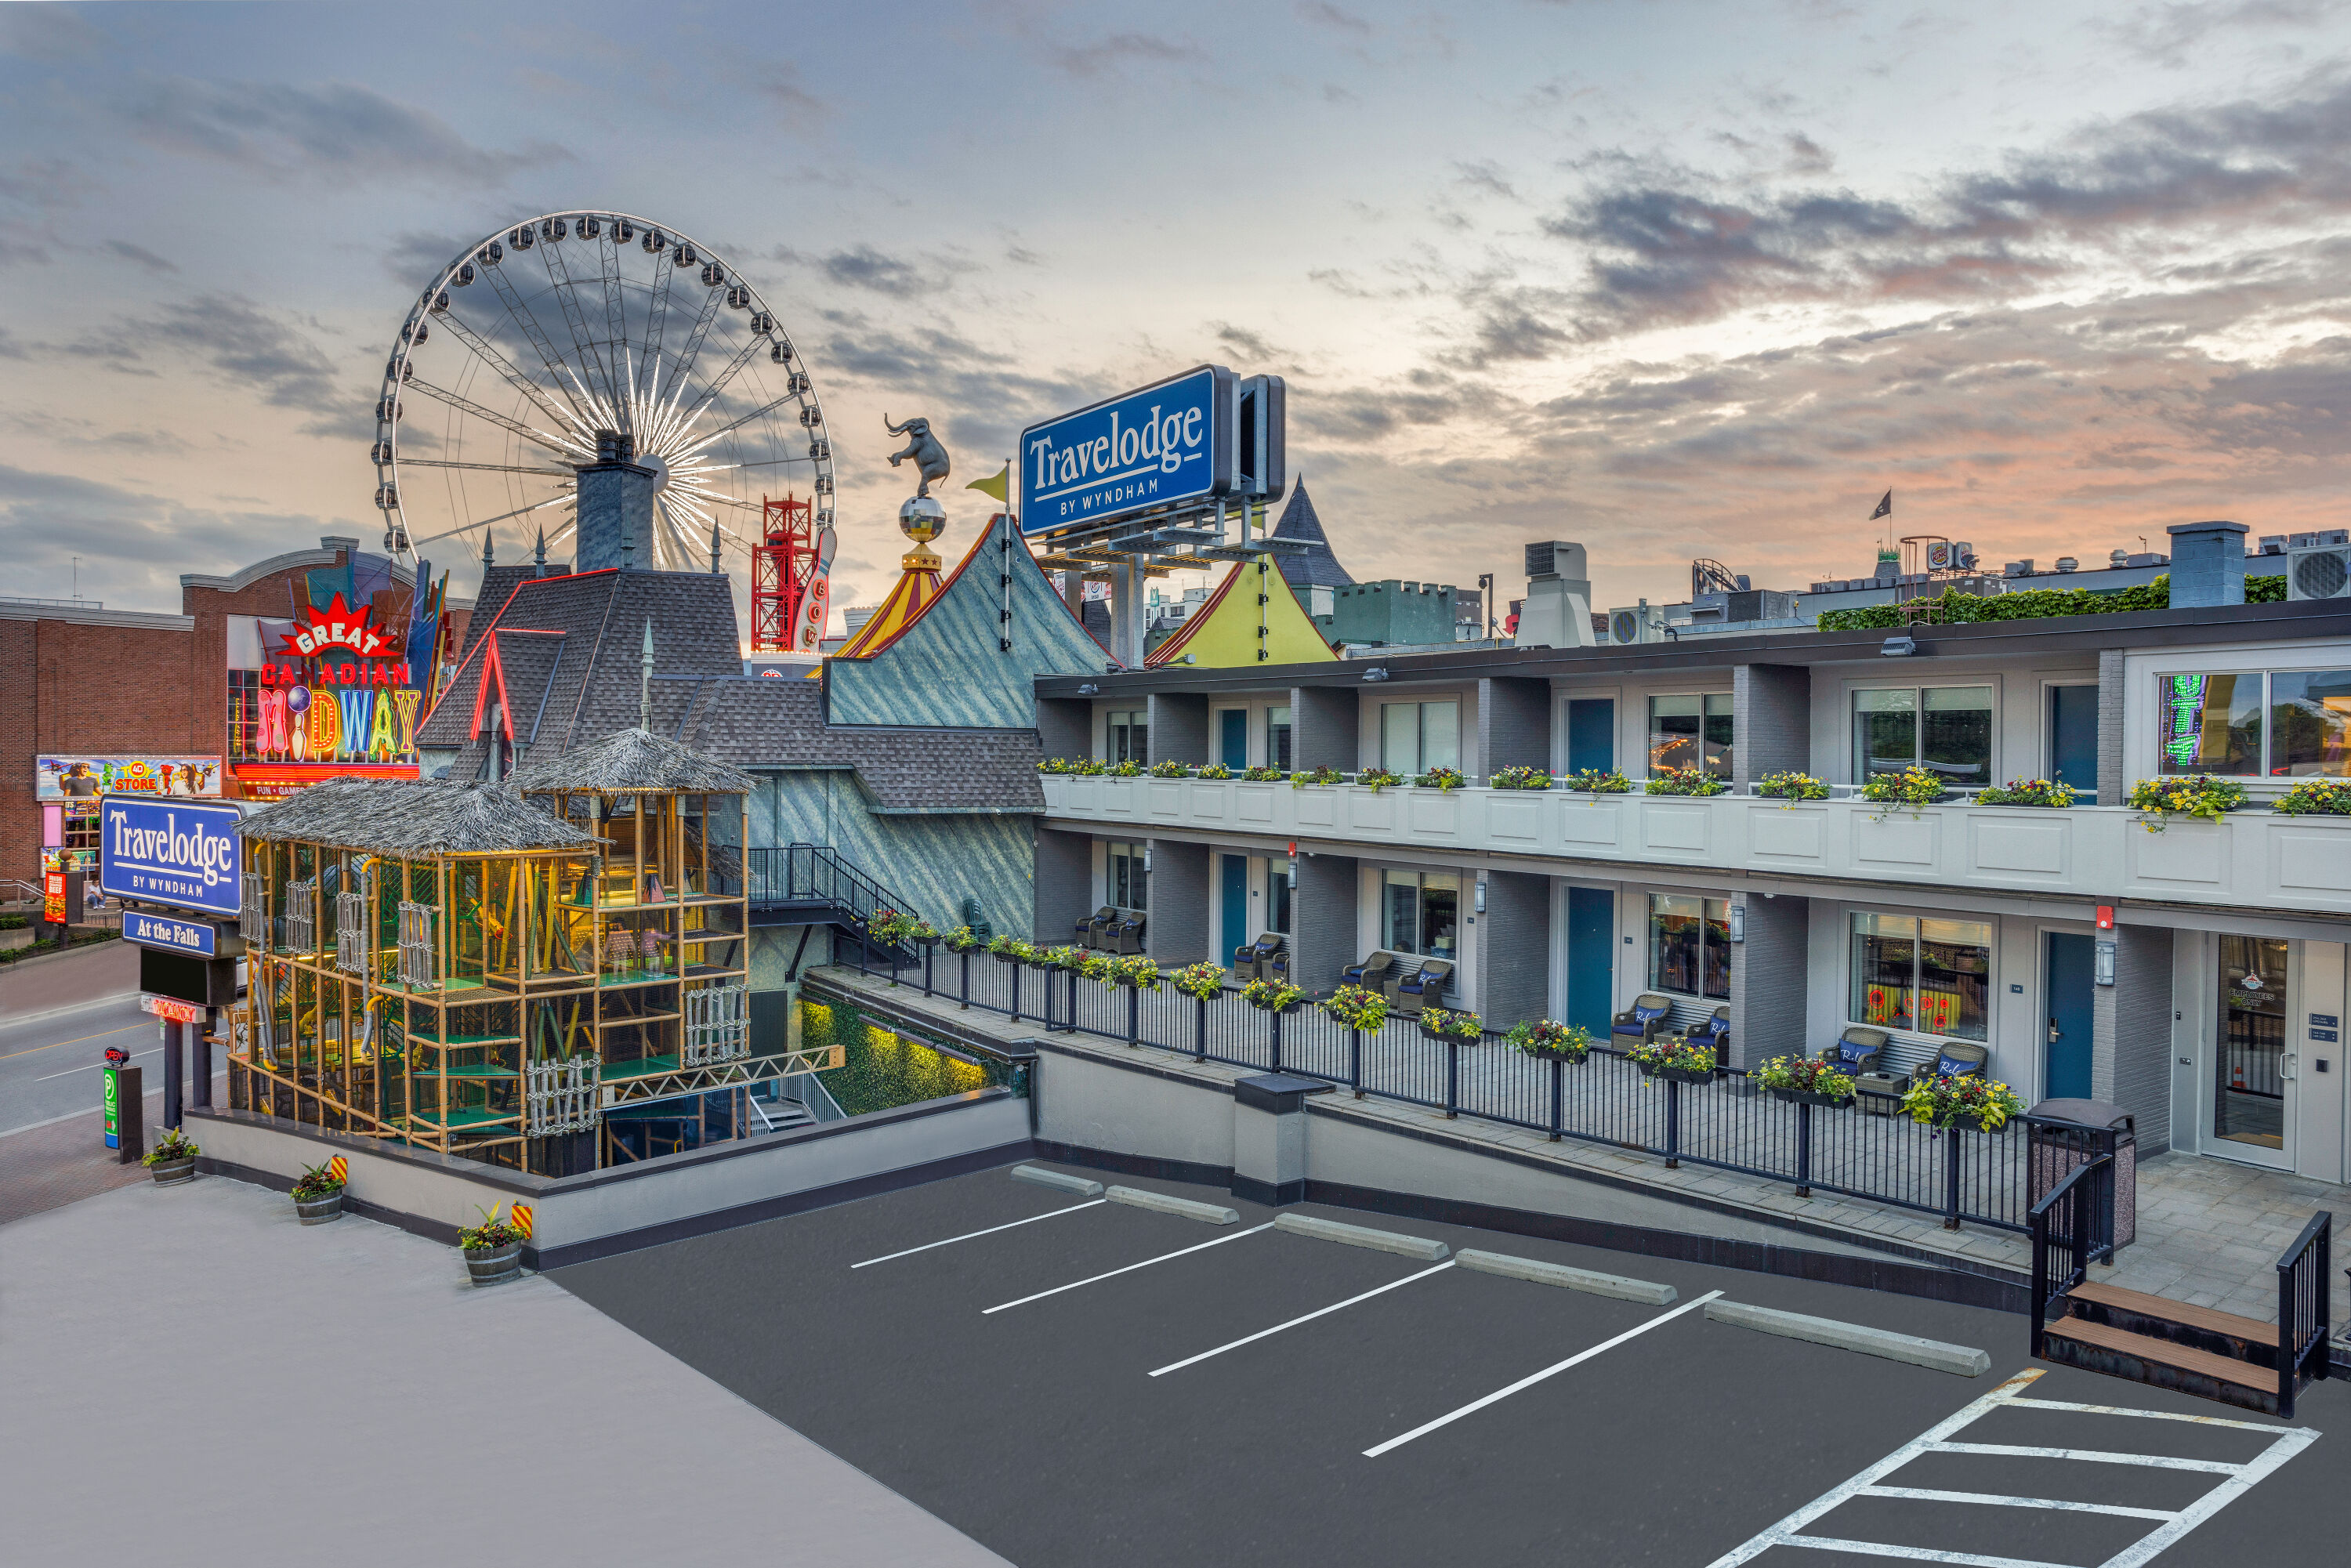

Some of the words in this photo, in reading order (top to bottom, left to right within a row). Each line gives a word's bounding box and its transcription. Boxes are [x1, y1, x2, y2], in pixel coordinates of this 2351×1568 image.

[1030, 404, 1203, 490] Travelodge
[1060, 499, 1075, 516] BY
[1082, 478, 1158, 509] WYNDHAM
[296, 623, 380, 654] GREAT
[261, 663, 410, 684] CANADIAN
[120, 760, 154, 779] TOY
[114, 778, 158, 791] STORE
[256, 786, 271, 795] FUN
[110, 809, 232, 887] Travelodge
[132, 875, 144, 888] BY
[149, 878, 203, 897] WYNDHAM
[137, 918, 150, 937] At
[157, 922, 171, 940] the
[173, 924, 200, 947] Falls
[2229, 989, 2275, 1001] EMPLOYEES
[2241, 998, 2262, 1007] ONLY
[153, 998, 195, 1023] VACANCY
[1636, 1011, 1650, 1022] Rel
[105, 1049, 123, 1060] OPEN
[1840, 1049, 1860, 1063] Rel
[1940, 1061, 1960, 1075] Rel
